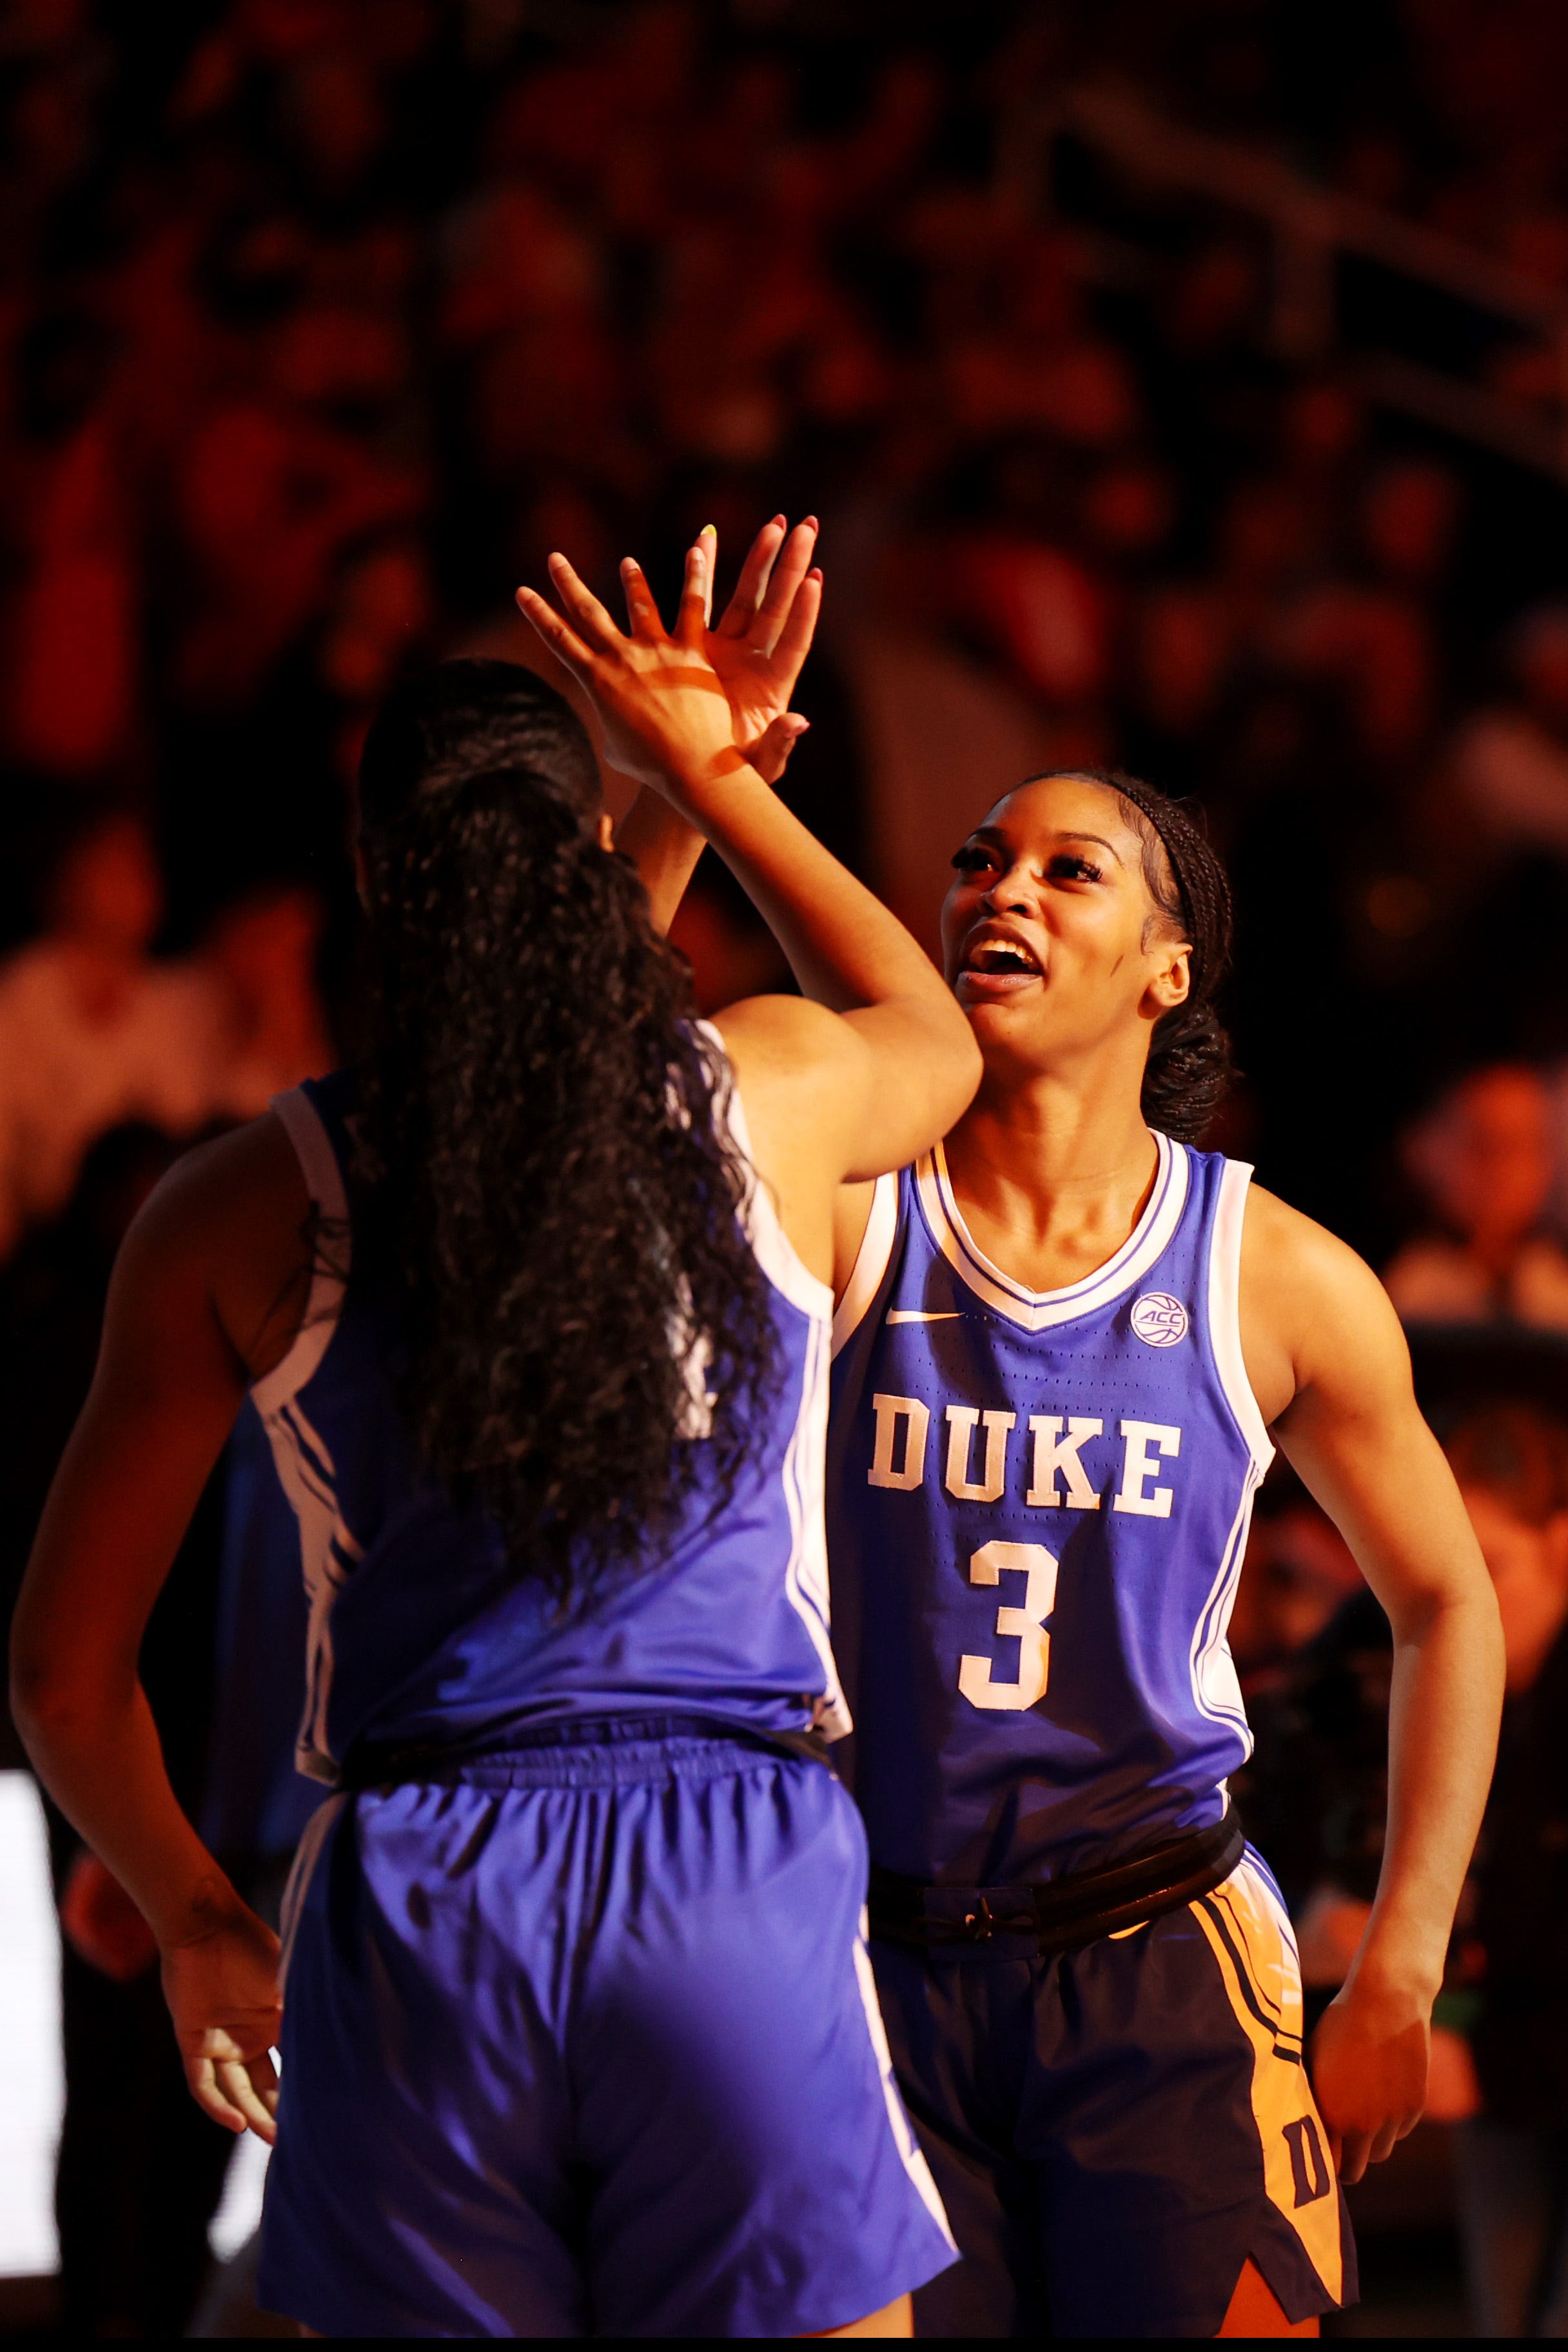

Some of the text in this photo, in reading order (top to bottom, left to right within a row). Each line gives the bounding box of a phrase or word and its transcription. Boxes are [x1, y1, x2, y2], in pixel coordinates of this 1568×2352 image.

[1139, 1310, 1184, 1324] ACC
[868, 1393, 1181, 1518] DUKE
[958, 1540, 1059, 1710] 3
[1282, 2114, 1330, 2209] D
